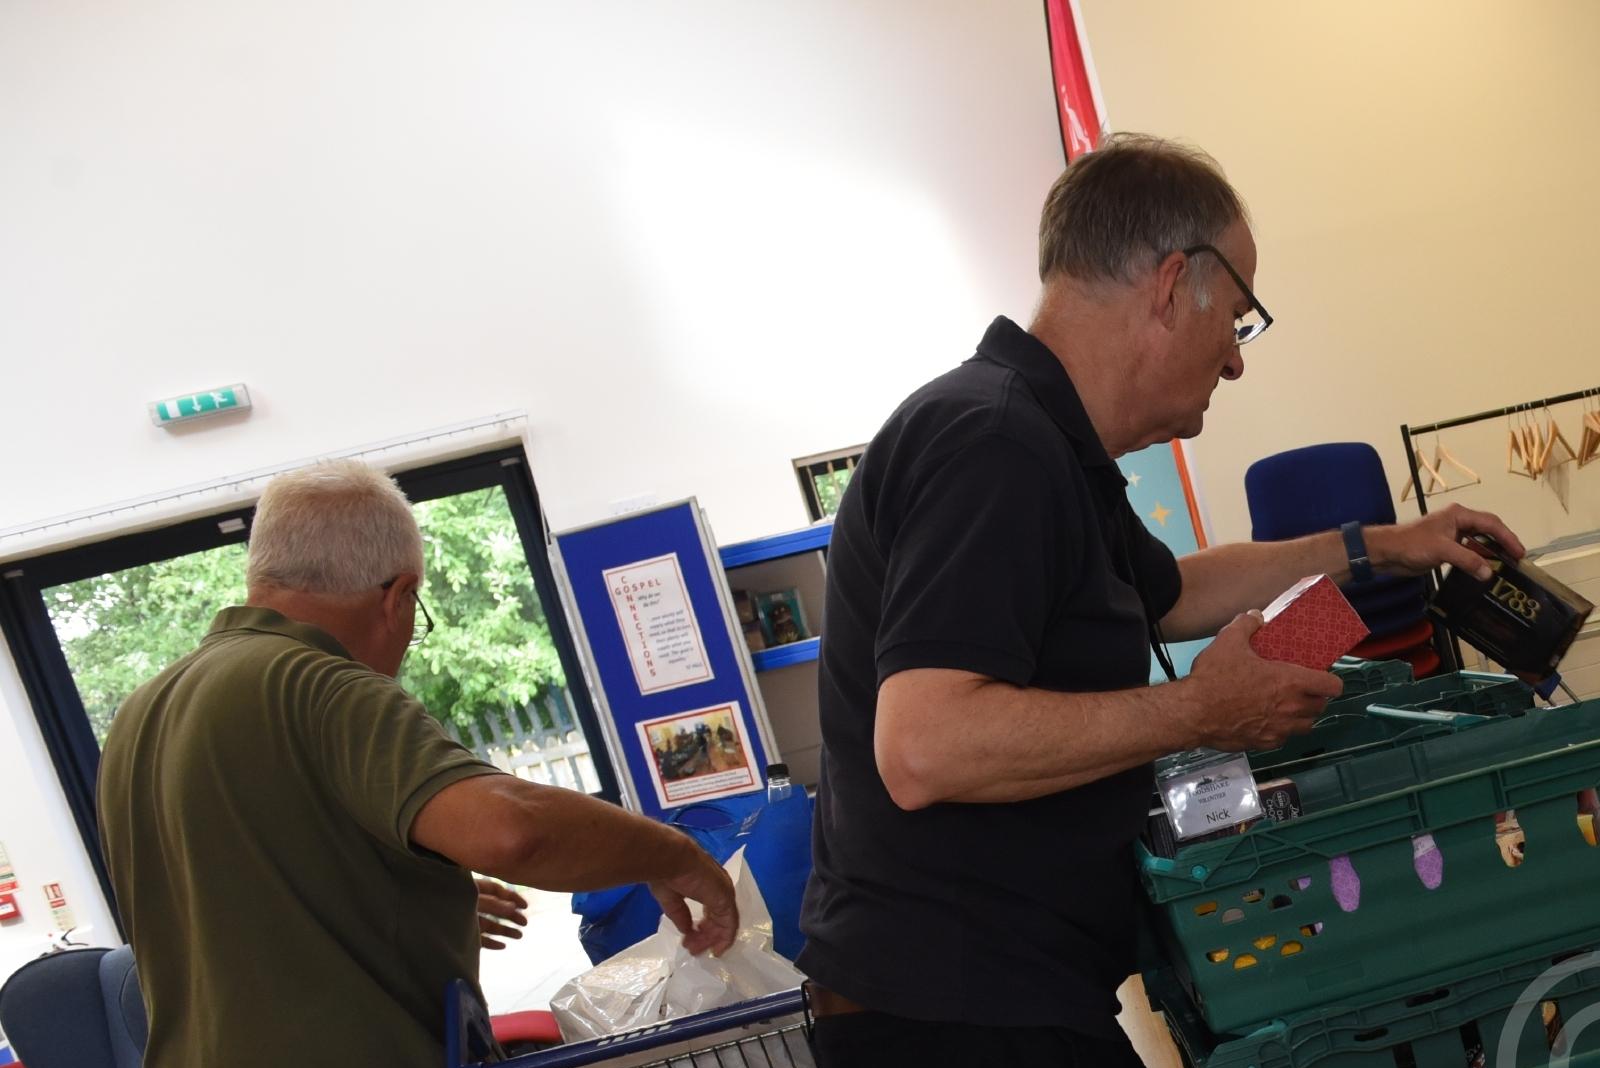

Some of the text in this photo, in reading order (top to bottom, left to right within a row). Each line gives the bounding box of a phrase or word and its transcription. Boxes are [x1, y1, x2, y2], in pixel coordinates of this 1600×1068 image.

[615, 579, 662, 596] GOSPEL
[1489, 576, 1541, 621] 1783
[621, 576, 656, 677] CONNECTIONS
[1206, 809, 1231, 824] Nick
